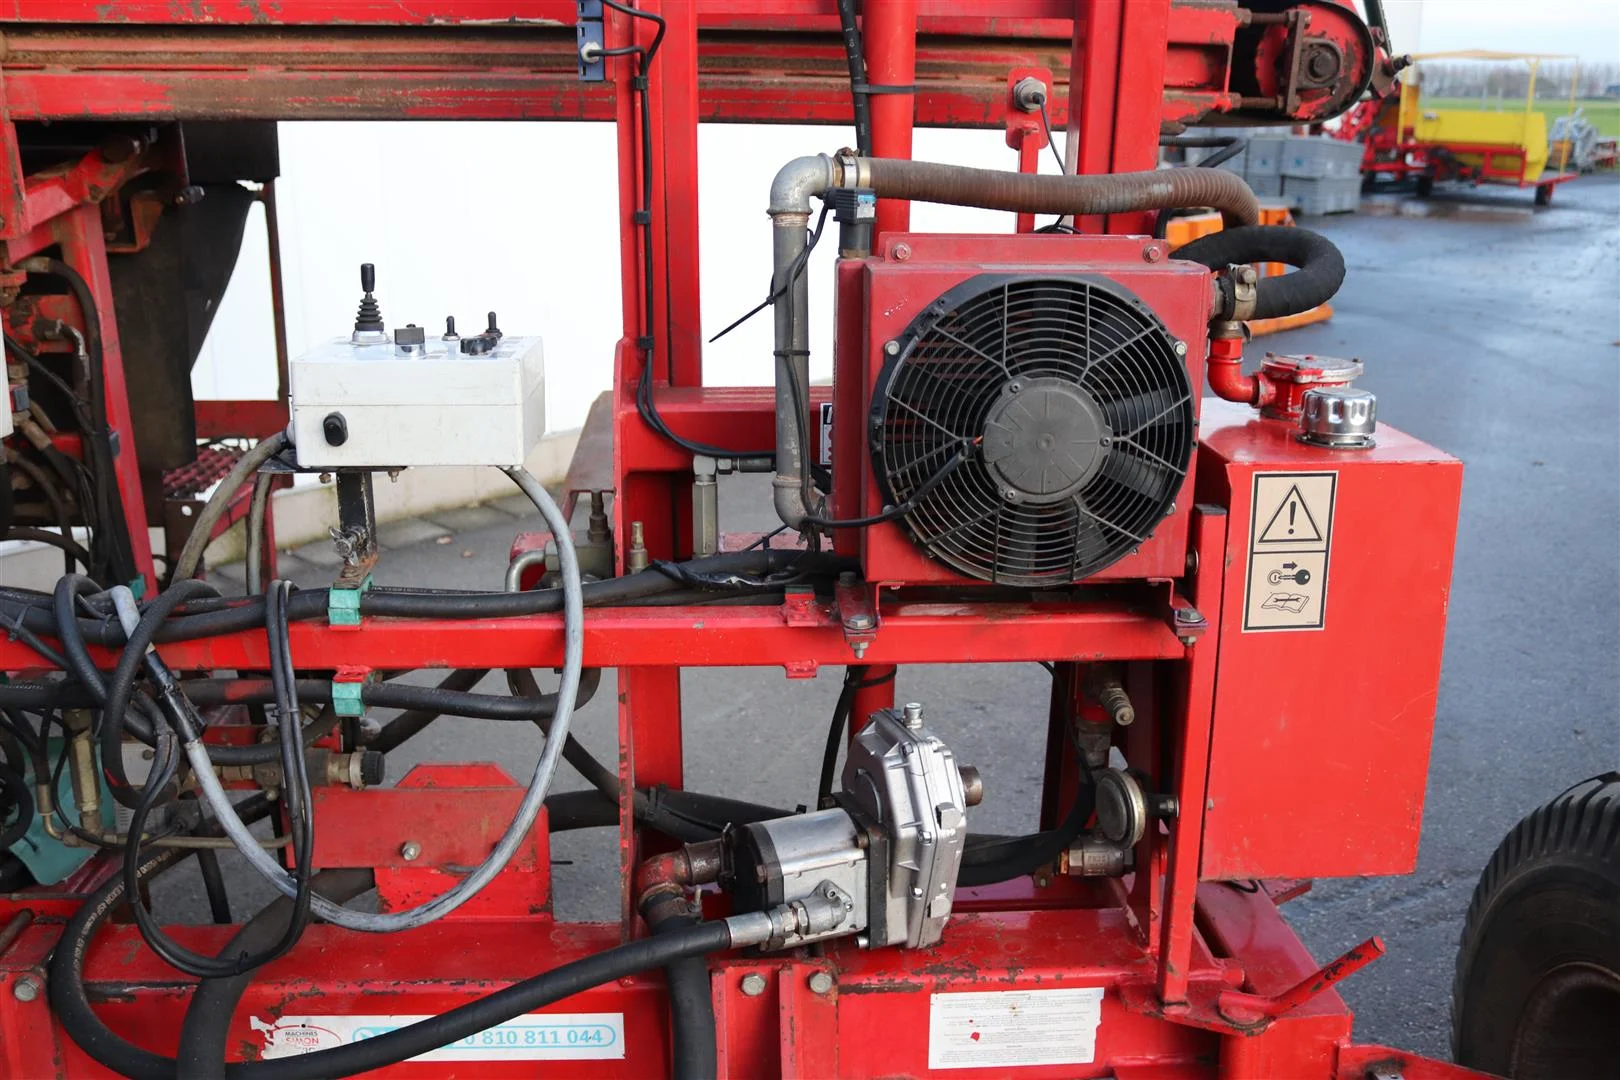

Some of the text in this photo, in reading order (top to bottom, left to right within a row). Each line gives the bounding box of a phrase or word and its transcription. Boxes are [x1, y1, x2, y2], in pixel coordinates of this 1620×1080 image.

[285, 1037, 319, 1045] SIMON
[482, 1030, 517, 1045] 810
[524, 1030, 560, 1045] 811
[567, 1029, 603, 1044] 044
